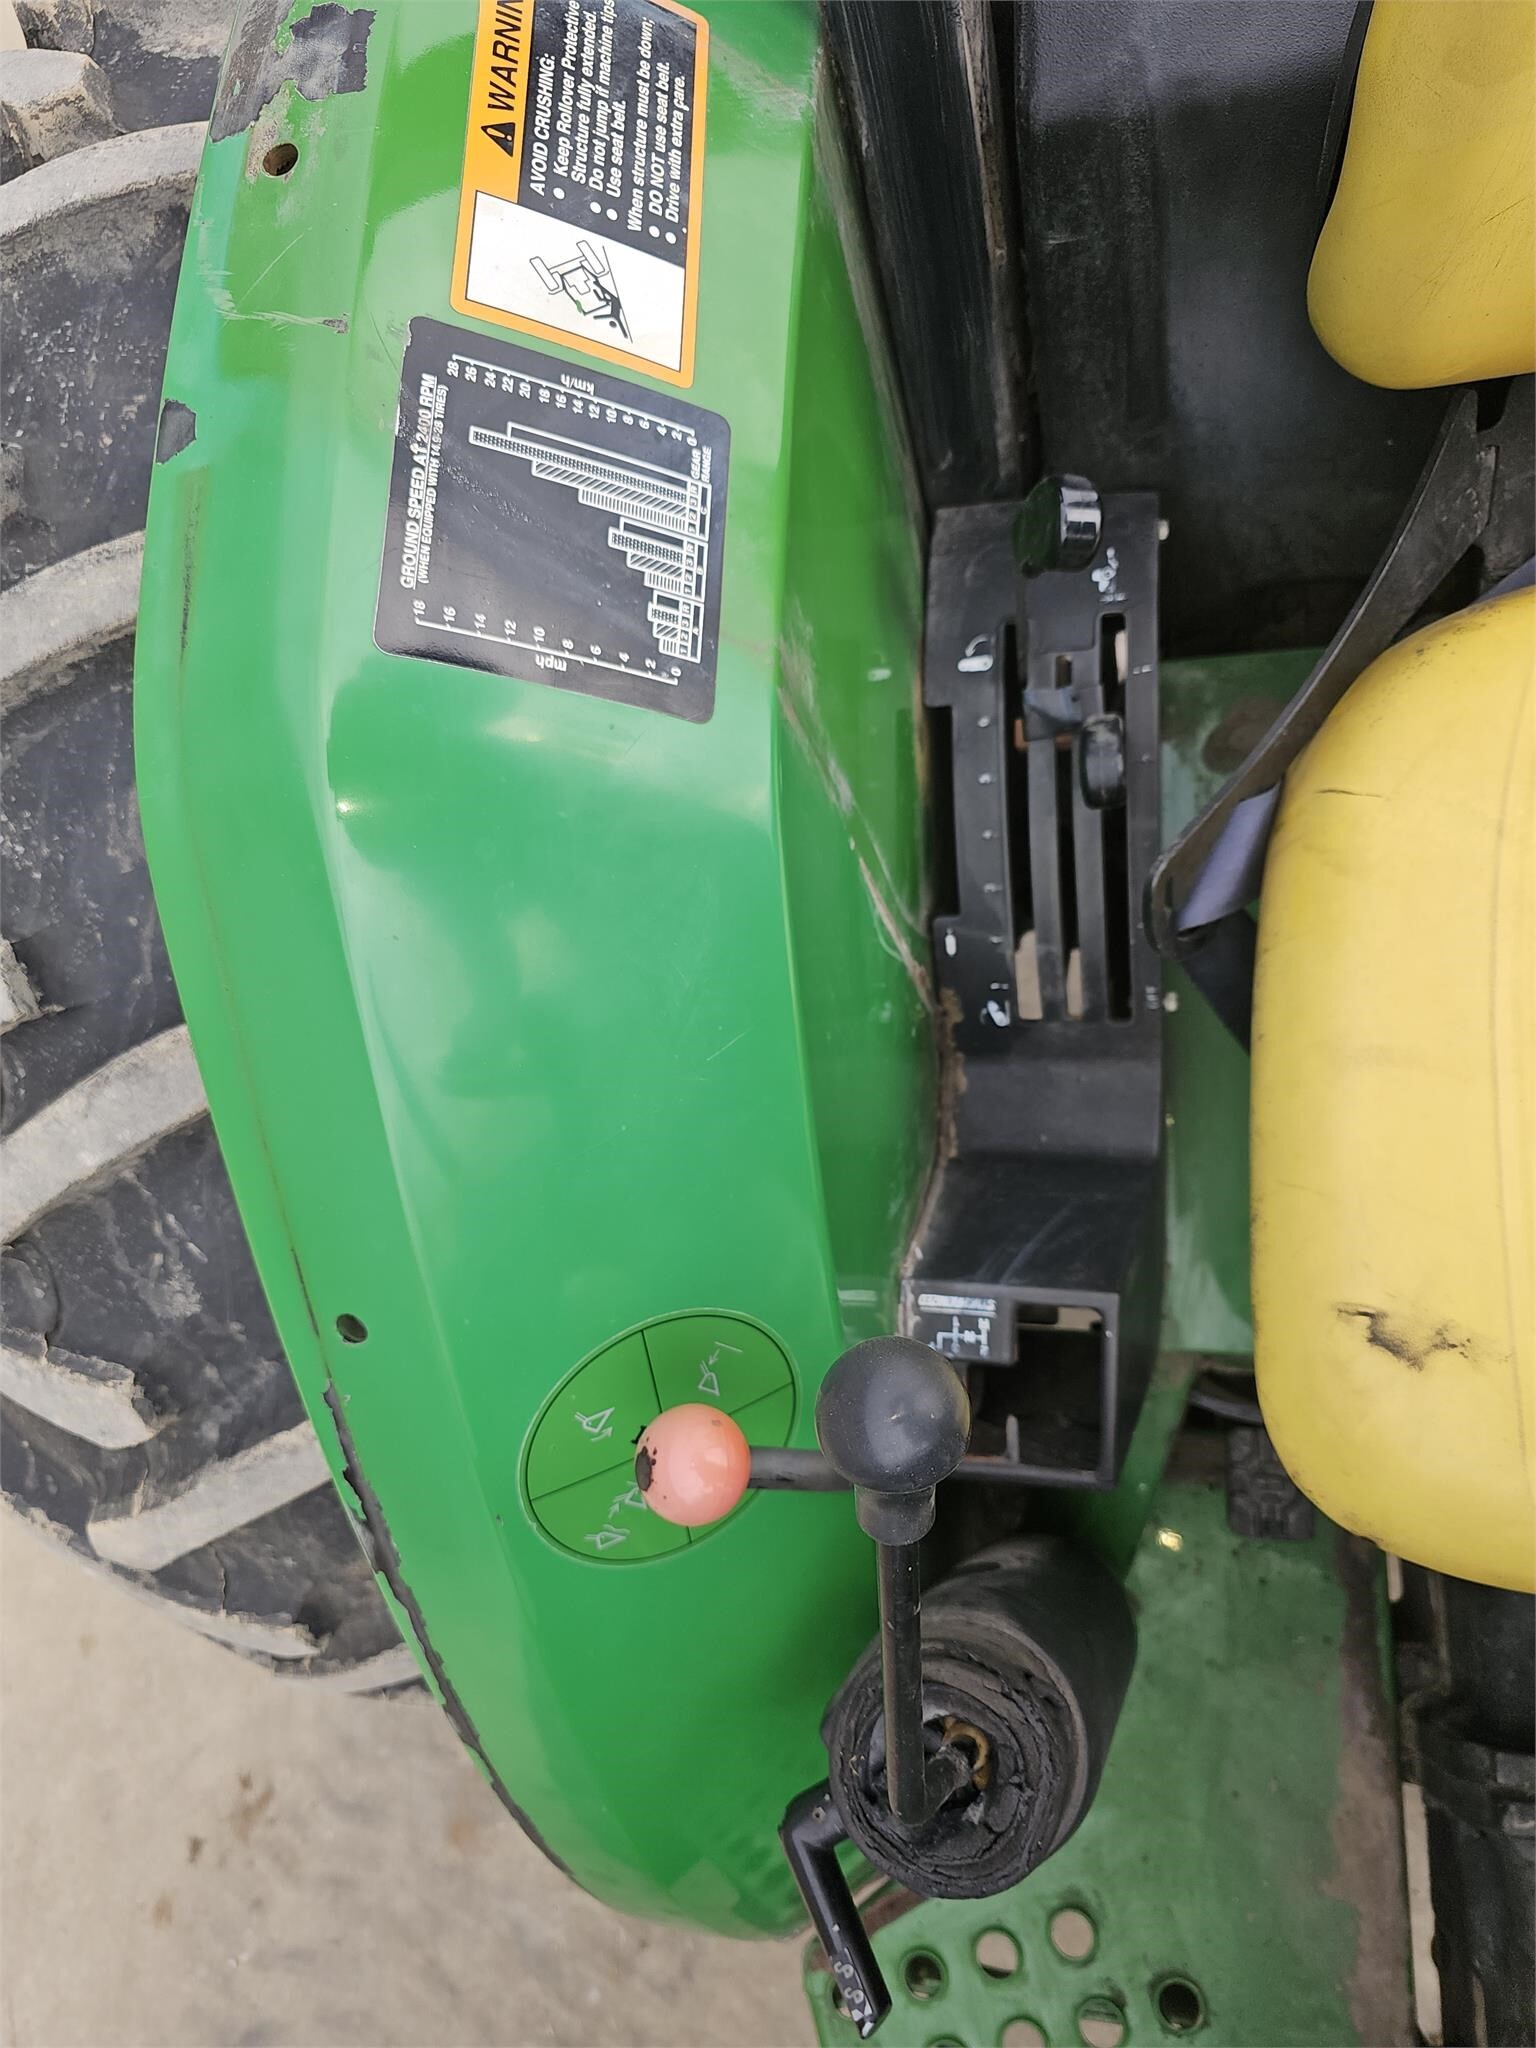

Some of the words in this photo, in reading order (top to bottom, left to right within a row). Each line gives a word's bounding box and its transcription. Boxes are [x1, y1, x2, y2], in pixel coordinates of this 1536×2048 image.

[561, 0, 580, 70] Protective
[580, 11, 596, 77] extended.
[598, 26, 613, 85] machine
[636, 60, 650, 79] be
[655, 62, 670, 91] belt.
[534, 53, 555, 140] CRUSHING:
[556, 72, 575, 134] Rollover
[576, 78, 595, 112] fully
[595, 86, 610, 98] if
[636, 79, 650, 118] must
[674, 76, 685, 108] care.
[593, 100, 611, 141] jump
[611, 100, 626, 131] belt.
[656, 92, 668, 124] seat
[655, 125, 666, 152] use
[671, 110, 683, 147] extra
[553, 137, 573, 177] Keep
[571, 114, 590, 184] Structure
[592, 140, 606, 166] not
[611, 132, 624, 166] seat
[632, 119, 647, 186] structure
[530, 142, 548, 196] AVOID
[650, 152, 665, 189] NOT
[668, 149, 682, 180] with
[589, 169, 604, 191] Do
[606, 167, 622, 198] Use
[627, 188, 644, 231] When
[649, 190, 663, 216] DO
[665, 182, 680, 223] Drive
[447, 361, 458, 377] 28
[465, 366, 477, 382] 26
[484, 372, 496, 388] 24
[420, 373, 435, 407] RPM
[502, 376, 513, 393] 22
[519, 382, 530, 399] 20
[538, 389, 550, 403] 18
[561, 374, 594, 396] km/h
[435, 384, 448, 418] TIRES)
[555, 394, 566, 408] 16
[572, 399, 583, 414] 14
[589, 404, 600, 419] 12
[416, 409, 431, 443] 2400
[606, 408, 617, 423] 10
[622, 415, 633, 425] 8
[639, 419, 650, 430] 6
[656, 426, 667, 436] 4
[671, 430, 682, 441] 2
[687, 436, 697, 446] 0
[411, 443, 427, 466] AT
[691, 448, 701, 479] GEAR
[702, 445, 711, 482] RANGE
[428, 457, 440, 486] WITH
[407, 467, 425, 519] SPEED
[421, 487, 436, 544] EQUIPPED
[400, 520, 420, 588] GROUND
[418, 545, 430, 583] (WHEN
[413, 600, 425, 615] 18
[443, 606, 456, 621] 16
[474, 613, 486, 629] 14
[504, 620, 516, 636] 12
[533, 626, 545, 642] 10
[562, 639, 574, 649] 8
[590, 644, 601, 655] 6
[618, 652, 630, 662] 4
[536, 654, 567, 672] mph
[645, 658, 656, 669] 2
[671, 667, 681, 676] 0
